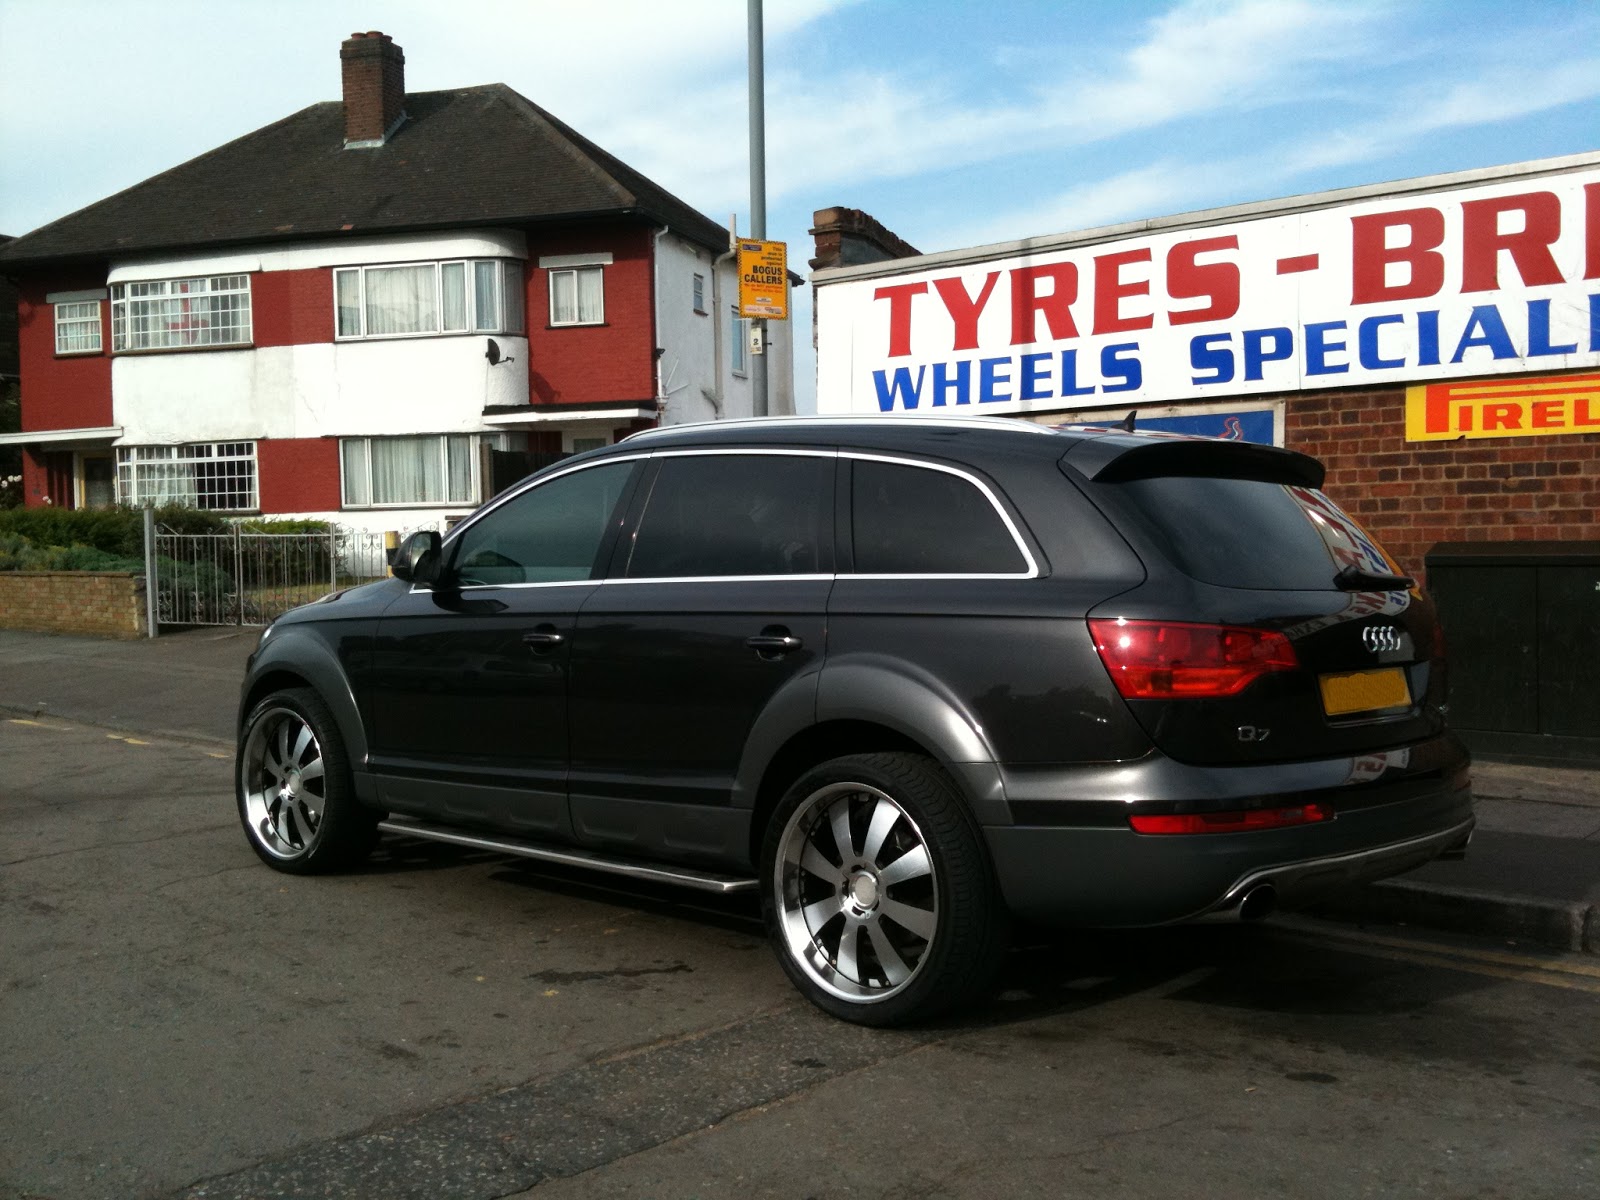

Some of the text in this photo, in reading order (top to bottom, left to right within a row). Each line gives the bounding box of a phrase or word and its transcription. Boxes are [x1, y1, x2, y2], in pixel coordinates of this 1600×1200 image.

[752, 265, 783, 275] BOGUS
[744, 274, 783, 285] CALLERS
[874, 235, 1240, 357] TYRES
[873, 342, 1143, 412] WHEELS
[1237, 725, 1271, 741] Q7
